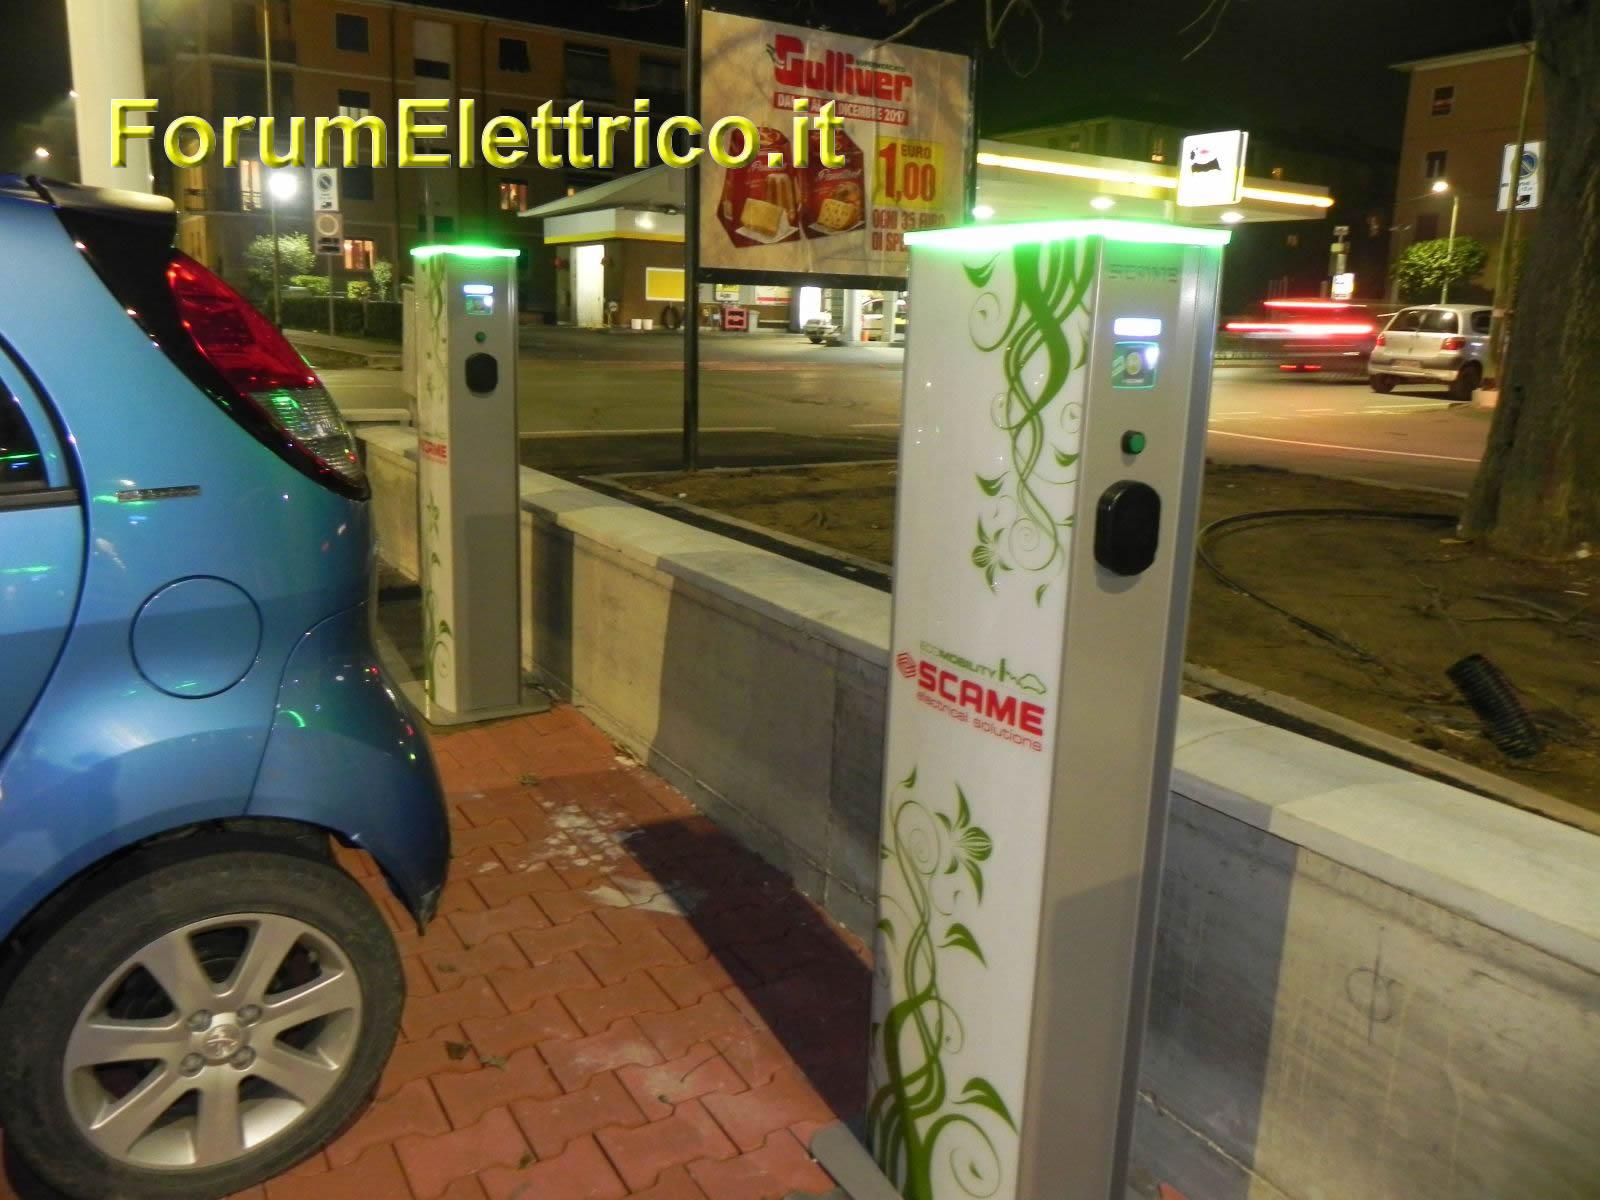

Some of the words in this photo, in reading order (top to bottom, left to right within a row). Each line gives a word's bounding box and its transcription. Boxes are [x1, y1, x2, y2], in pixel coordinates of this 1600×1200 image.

[774, 34, 912, 102] Gulliver
[901, 144, 932, 159] EURO
[918, 660, 1045, 737] SCAME
[972, 717, 1042, 752] solutions
